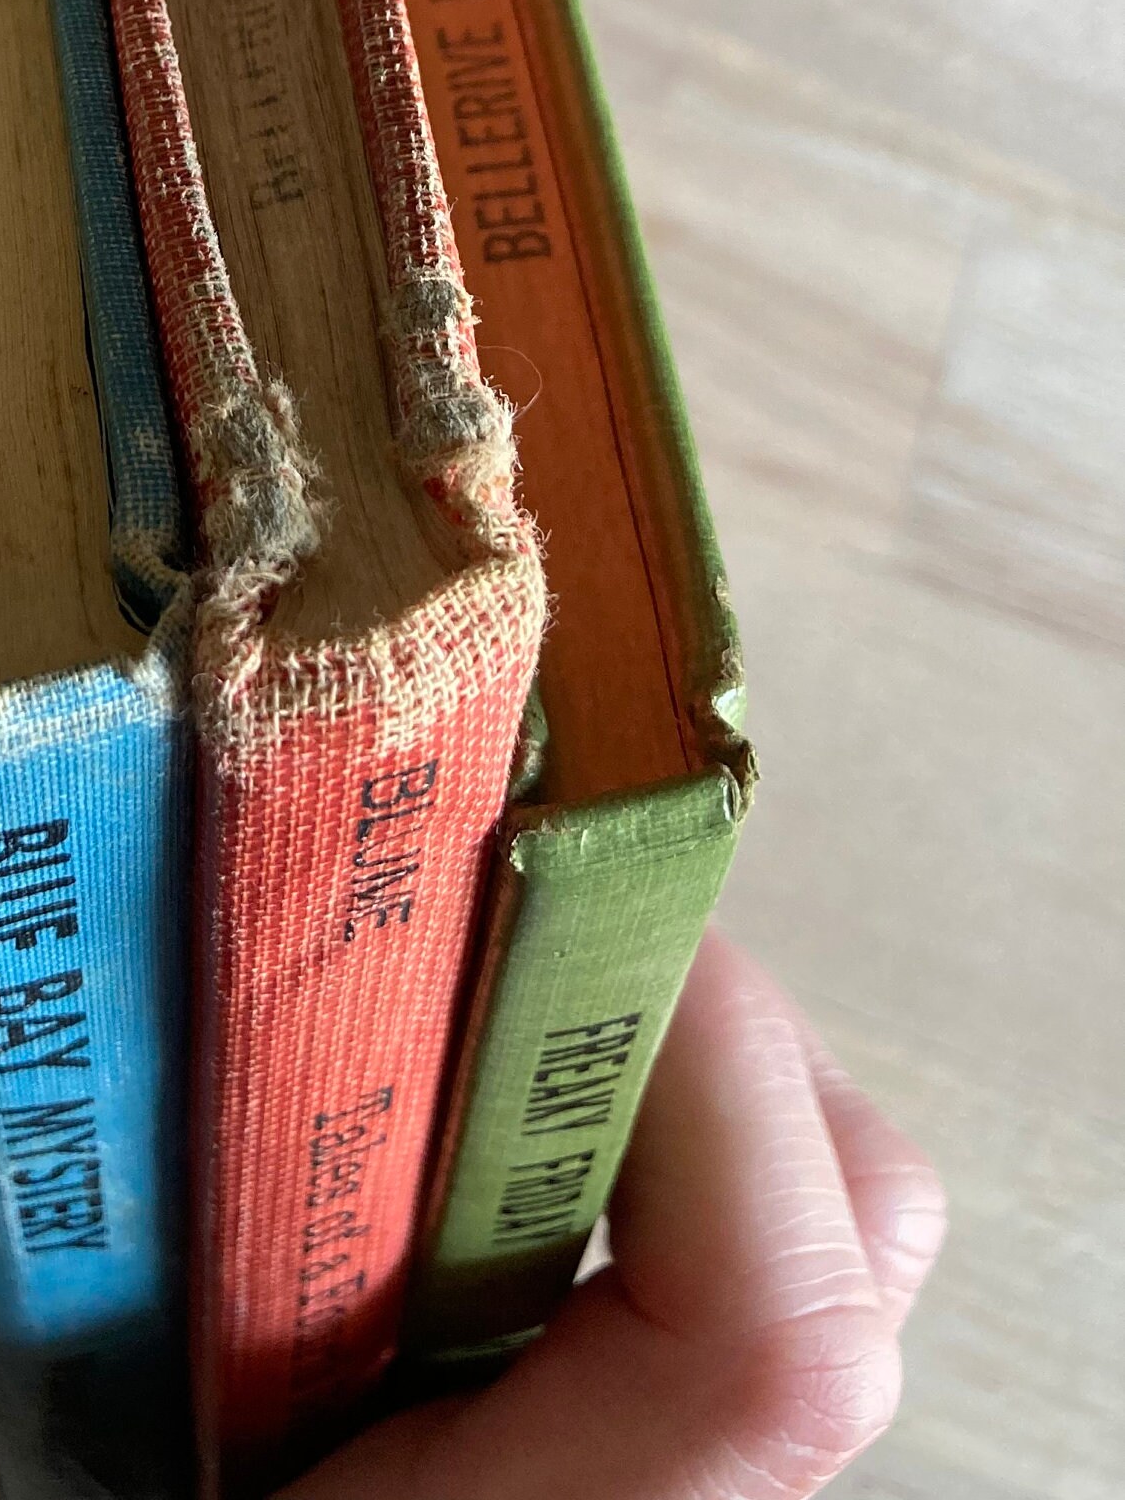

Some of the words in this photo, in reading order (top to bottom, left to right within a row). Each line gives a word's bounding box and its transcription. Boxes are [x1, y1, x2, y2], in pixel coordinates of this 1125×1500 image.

[436, 20, 552, 264] BELLERIVE
[343, 759, 439, 942] BLUME
[521, 1011, 643, 1137] FREAKY
[0, 1097, 109, 1254] MYSTERY
[306, 1086, 393, 1208] Tales
[491, 1149, 597, 1244] FRIDAY
[299, 1253, 350, 1281] a
[302, 1211, 371, 1253] of
